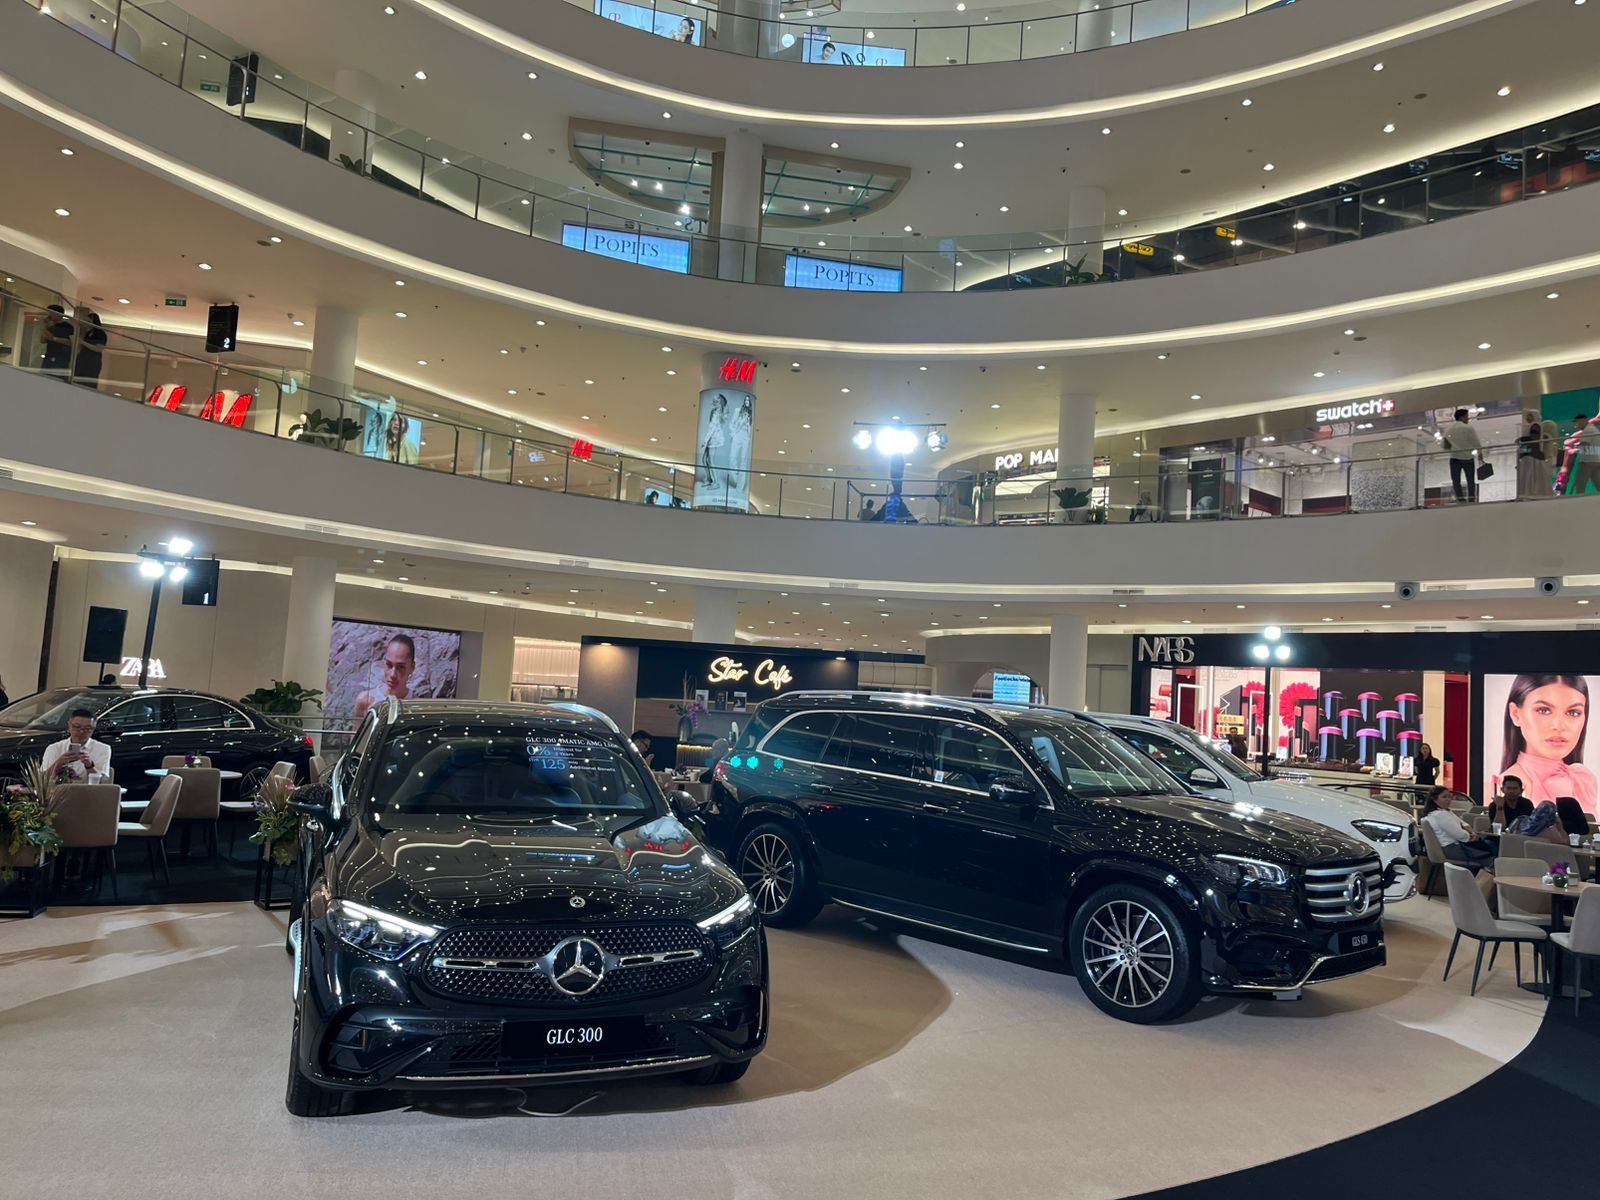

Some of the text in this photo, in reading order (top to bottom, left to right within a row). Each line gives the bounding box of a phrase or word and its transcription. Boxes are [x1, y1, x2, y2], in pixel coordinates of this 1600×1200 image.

[594, 234, 659, 258] POPITS
[815, 264, 875, 287] POPITS
[223, 337, 231, 349] 2
[1316, 398, 1384, 422] swatch
[995, 447, 1058, 470] POP MA
[1138, 636, 1195, 663] NARS
[708, 656, 749, 682] Star
[525, 736, 541, 744] GLC
[541, 758, 566, 770] 125
[546, 1026, 603, 1045] GLC 300
